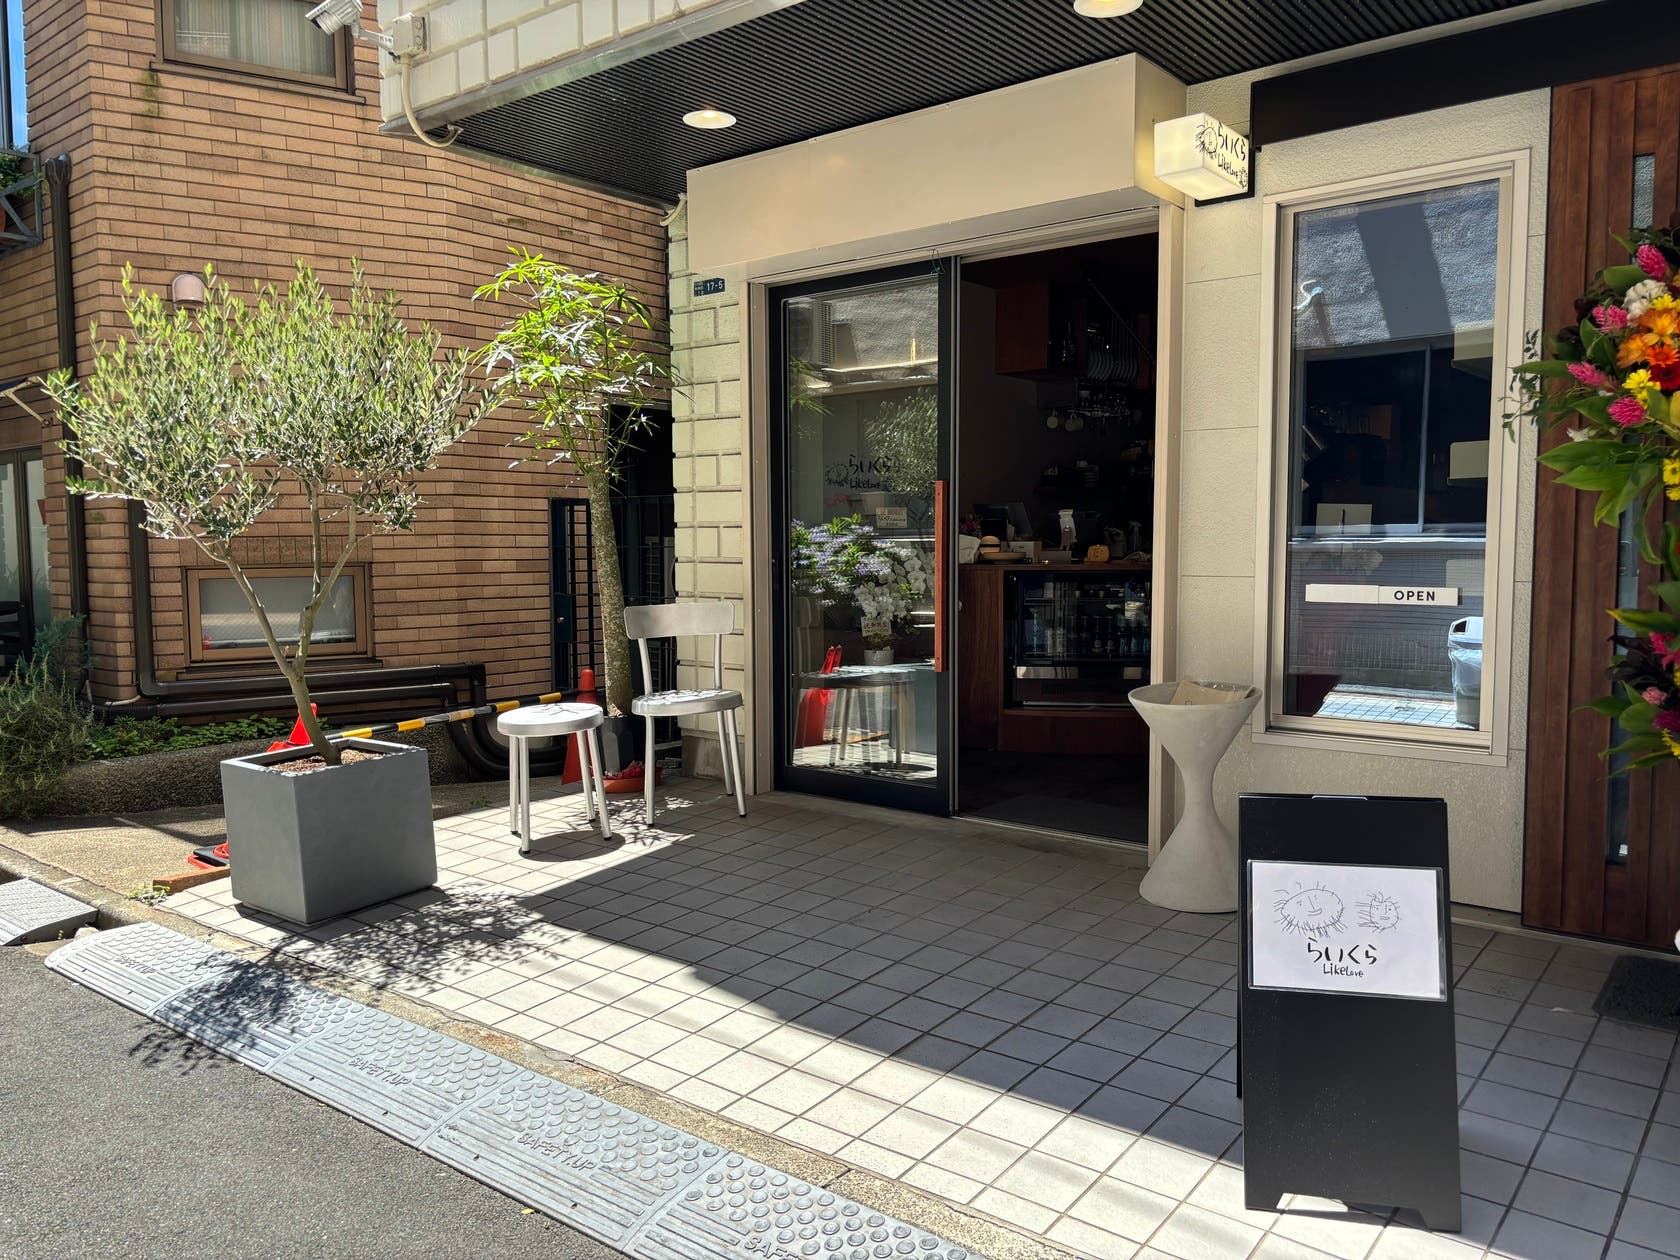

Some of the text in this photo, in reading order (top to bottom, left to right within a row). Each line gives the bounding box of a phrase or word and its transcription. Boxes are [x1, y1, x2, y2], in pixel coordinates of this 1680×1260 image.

[1218, 121, 1246, 161] らいくら
[707, 280, 723, 292] 17-5
[1394, 590, 1436, 601] OPEN
[1307, 936, 1378, 966] らいくら
